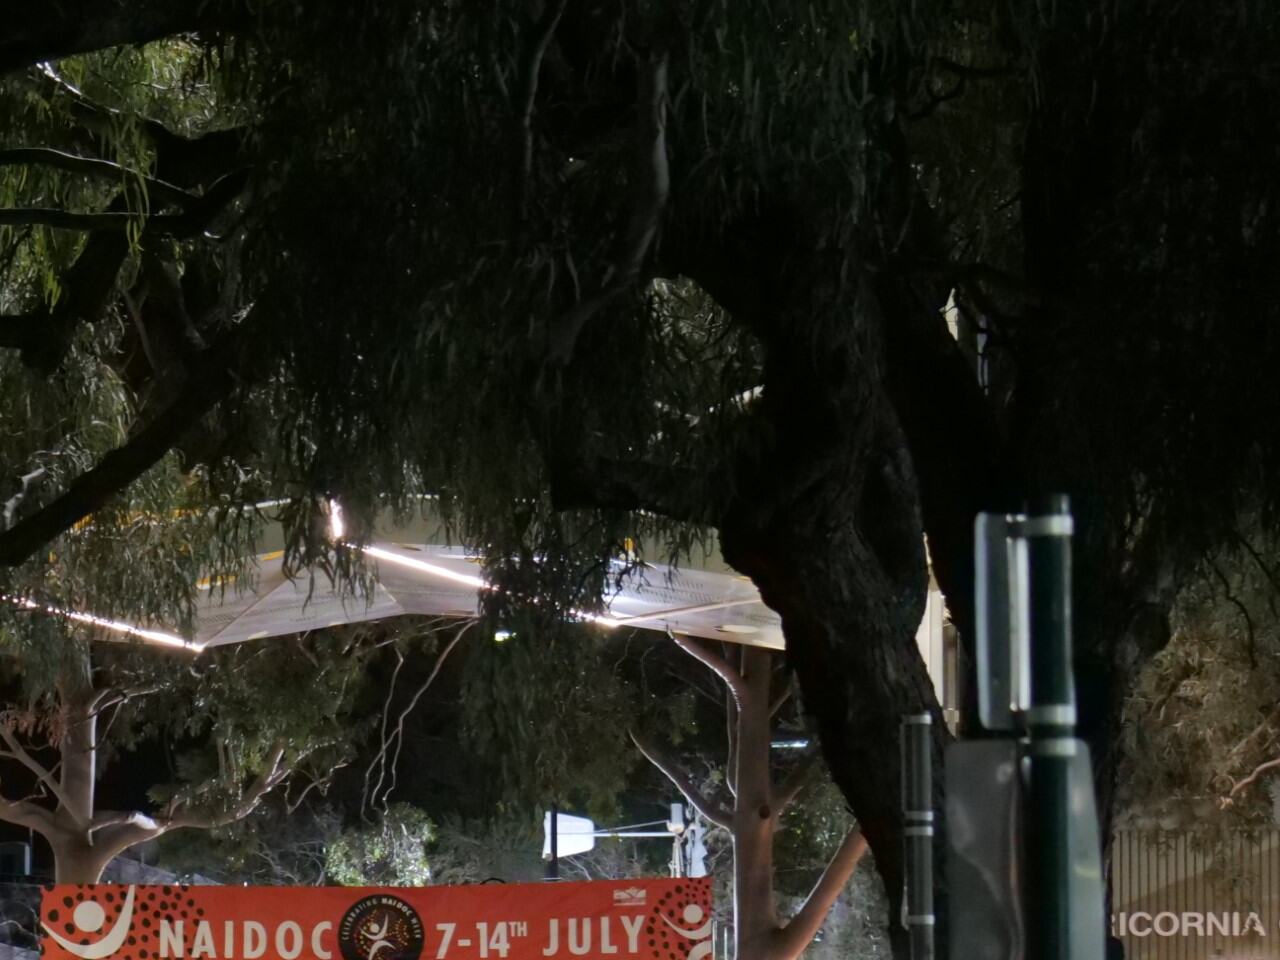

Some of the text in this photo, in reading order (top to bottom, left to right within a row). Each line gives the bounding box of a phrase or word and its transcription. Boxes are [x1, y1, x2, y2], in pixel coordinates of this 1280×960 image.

[381, 897, 414, 917] NAIDOC
[1111, 911, 1266, 937] ICORNIA
[159, 919, 332, 960] NAIDOC
[542, 915, 645, 956] JULY
